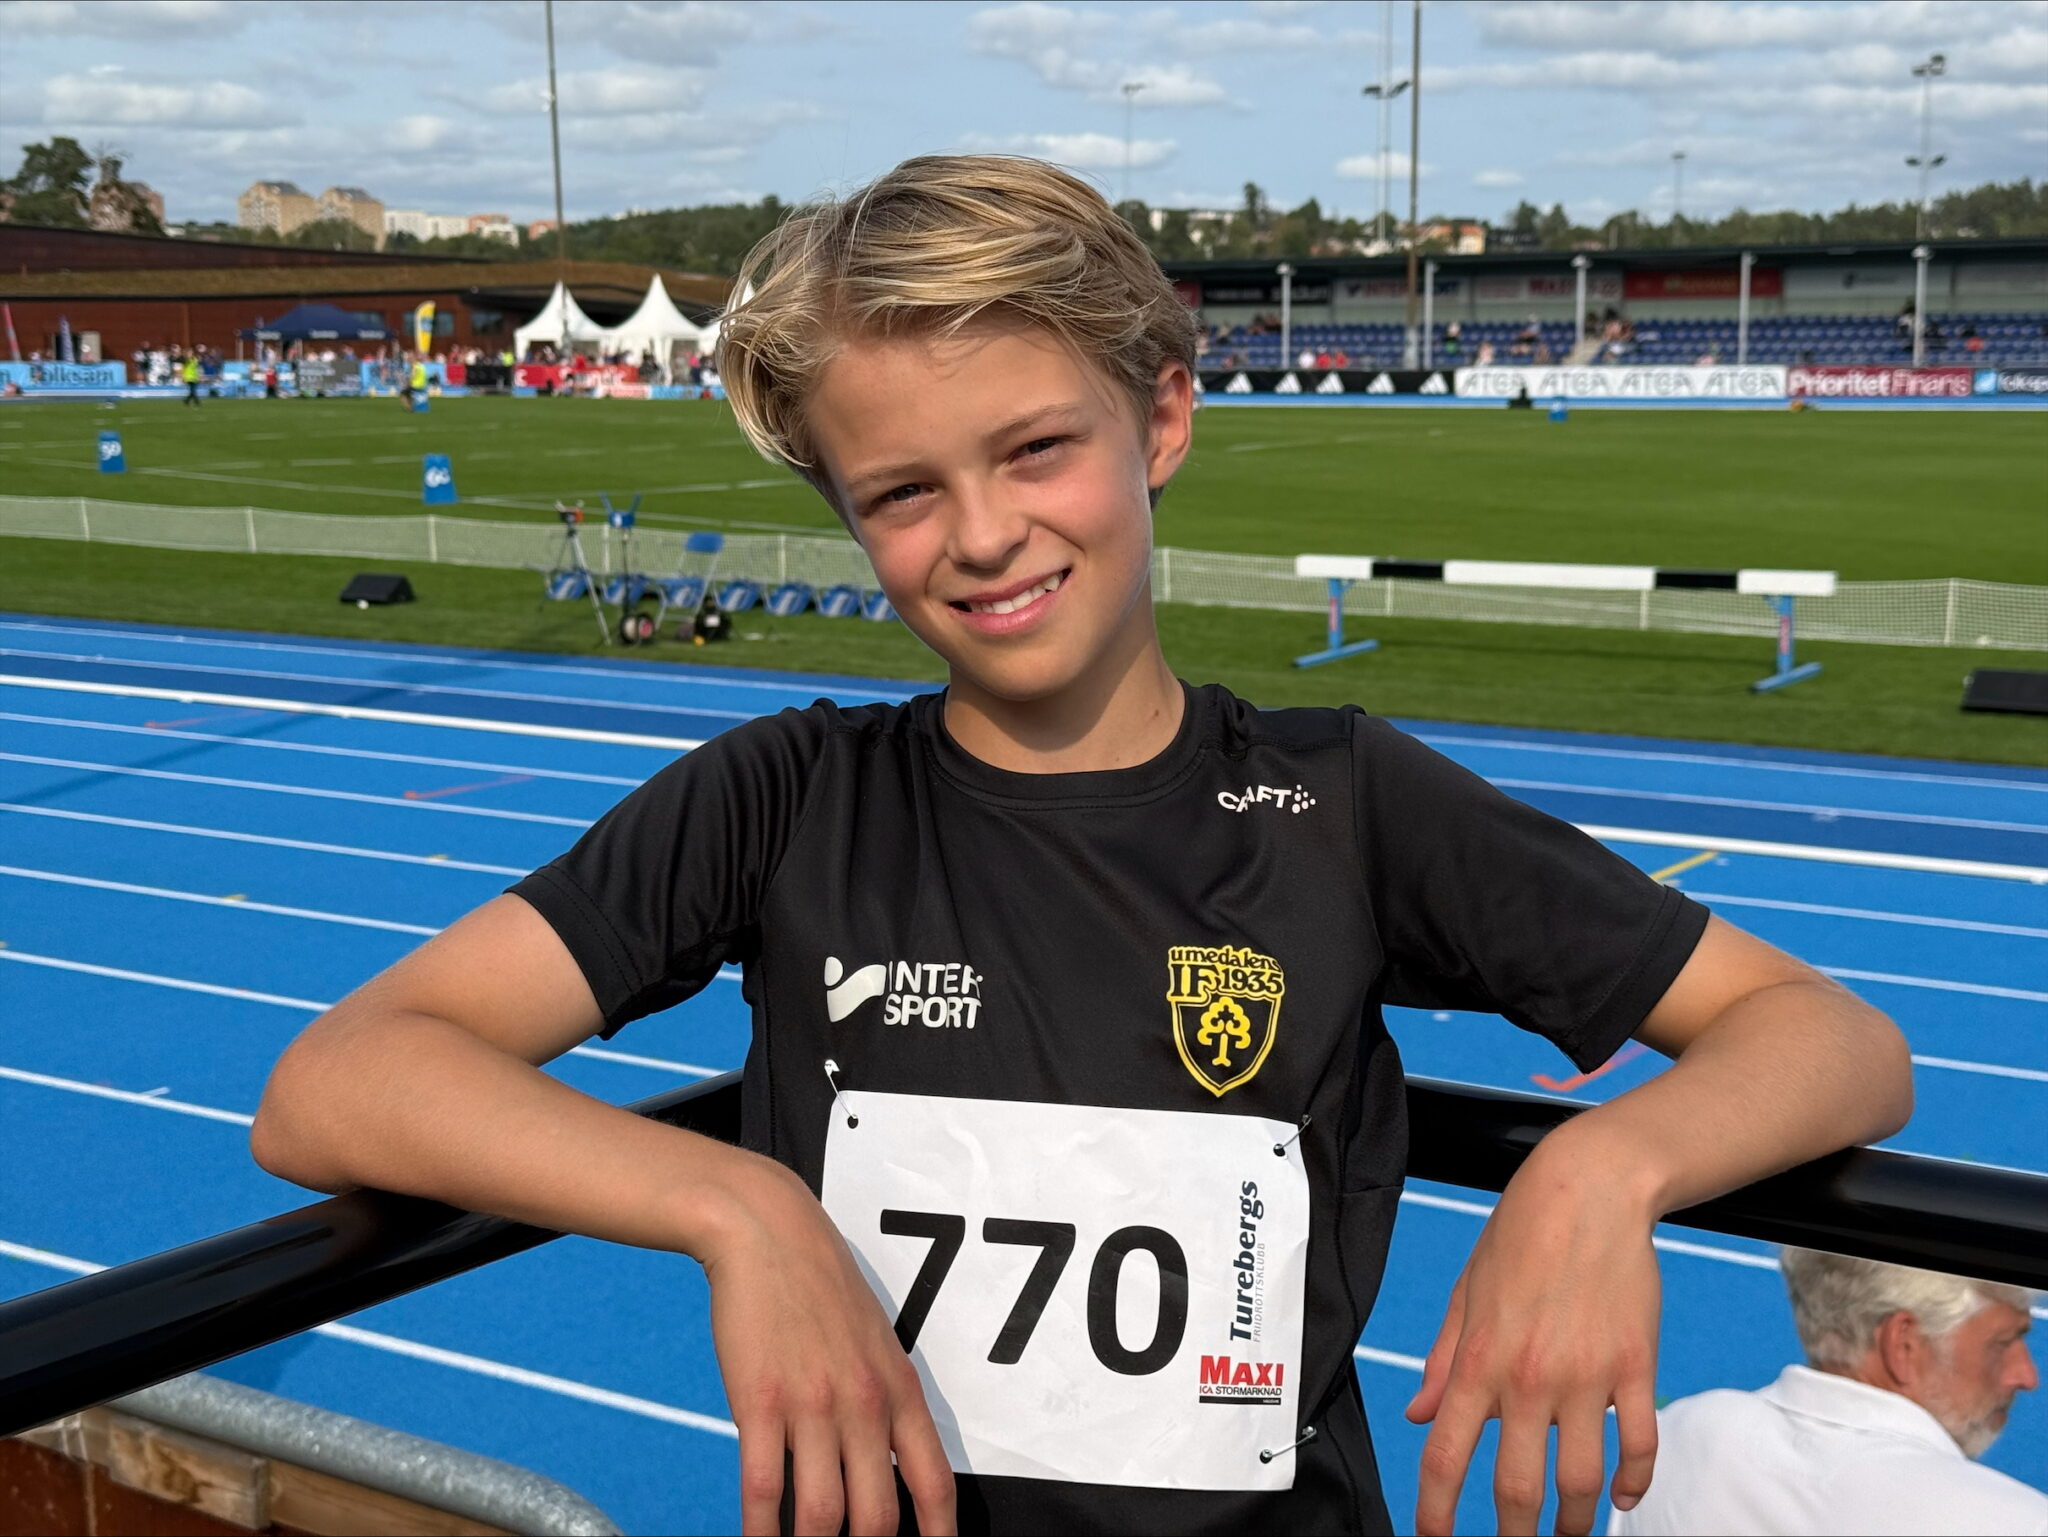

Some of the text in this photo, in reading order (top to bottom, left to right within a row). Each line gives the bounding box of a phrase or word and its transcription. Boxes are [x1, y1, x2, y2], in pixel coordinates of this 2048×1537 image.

[1788, 368, 1972, 396] Prioritet Finans
[1170, 964, 1283, 997] IF 1935
[884, 993, 982, 1029] SPORT
[1229, 1180, 1264, 1341] Turebergs
[880, 1209, 1189, 1376] 770
[1199, 1354, 1284, 1387] MAXI
[1199, 1385, 1283, 1396] ICA STORMARKNAD
